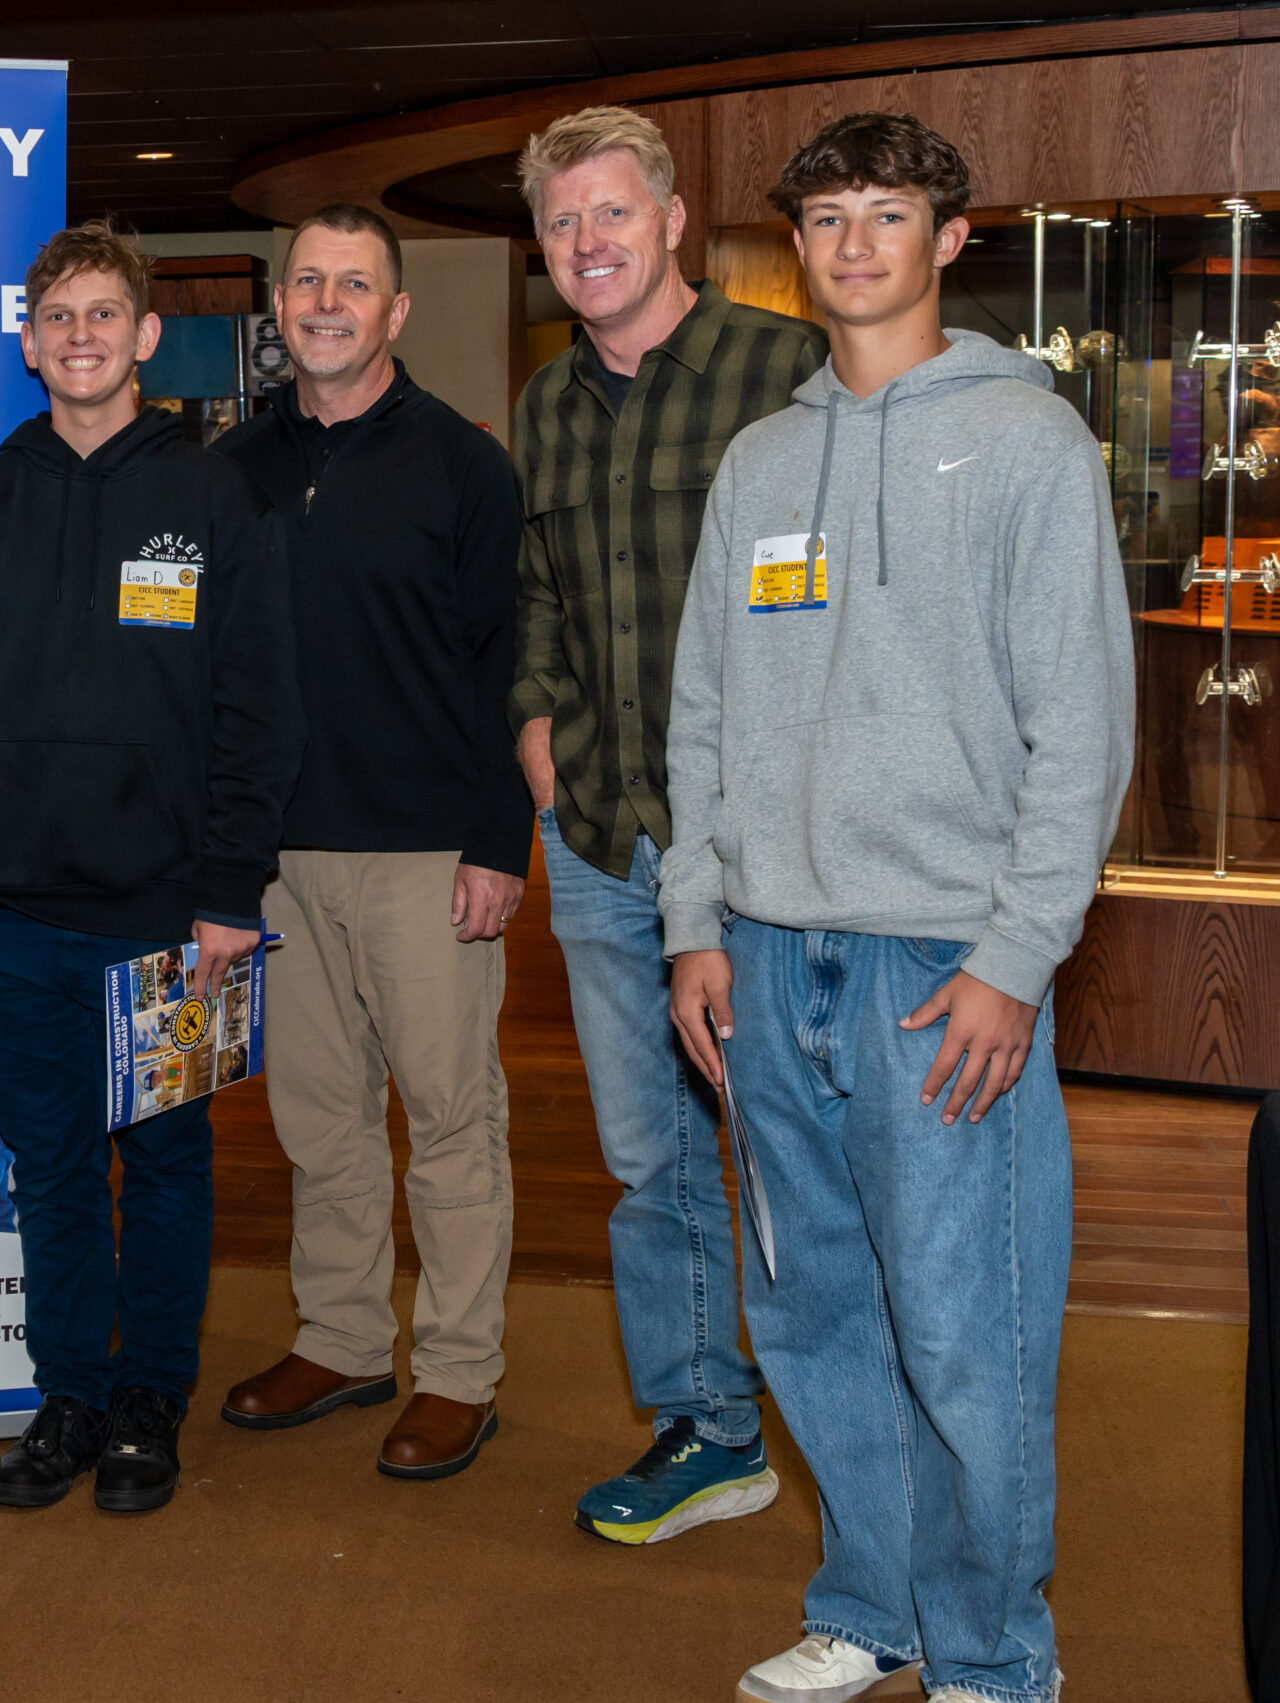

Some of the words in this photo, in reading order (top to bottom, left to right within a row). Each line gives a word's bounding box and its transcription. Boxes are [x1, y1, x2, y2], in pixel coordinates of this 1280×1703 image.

[139, 533, 204, 561] HURLEY
[155, 553, 176, 561] SURF
[126, 566, 149, 583] Liam
[153, 570, 163, 586] D
[768, 566, 780, 574] CICC
[138, 586, 152, 595] CICC
[153, 587, 180, 596] STUDENT
[111, 970, 122, 1057] CONSTRUCTION
[116, 1060, 122, 1072] IN
